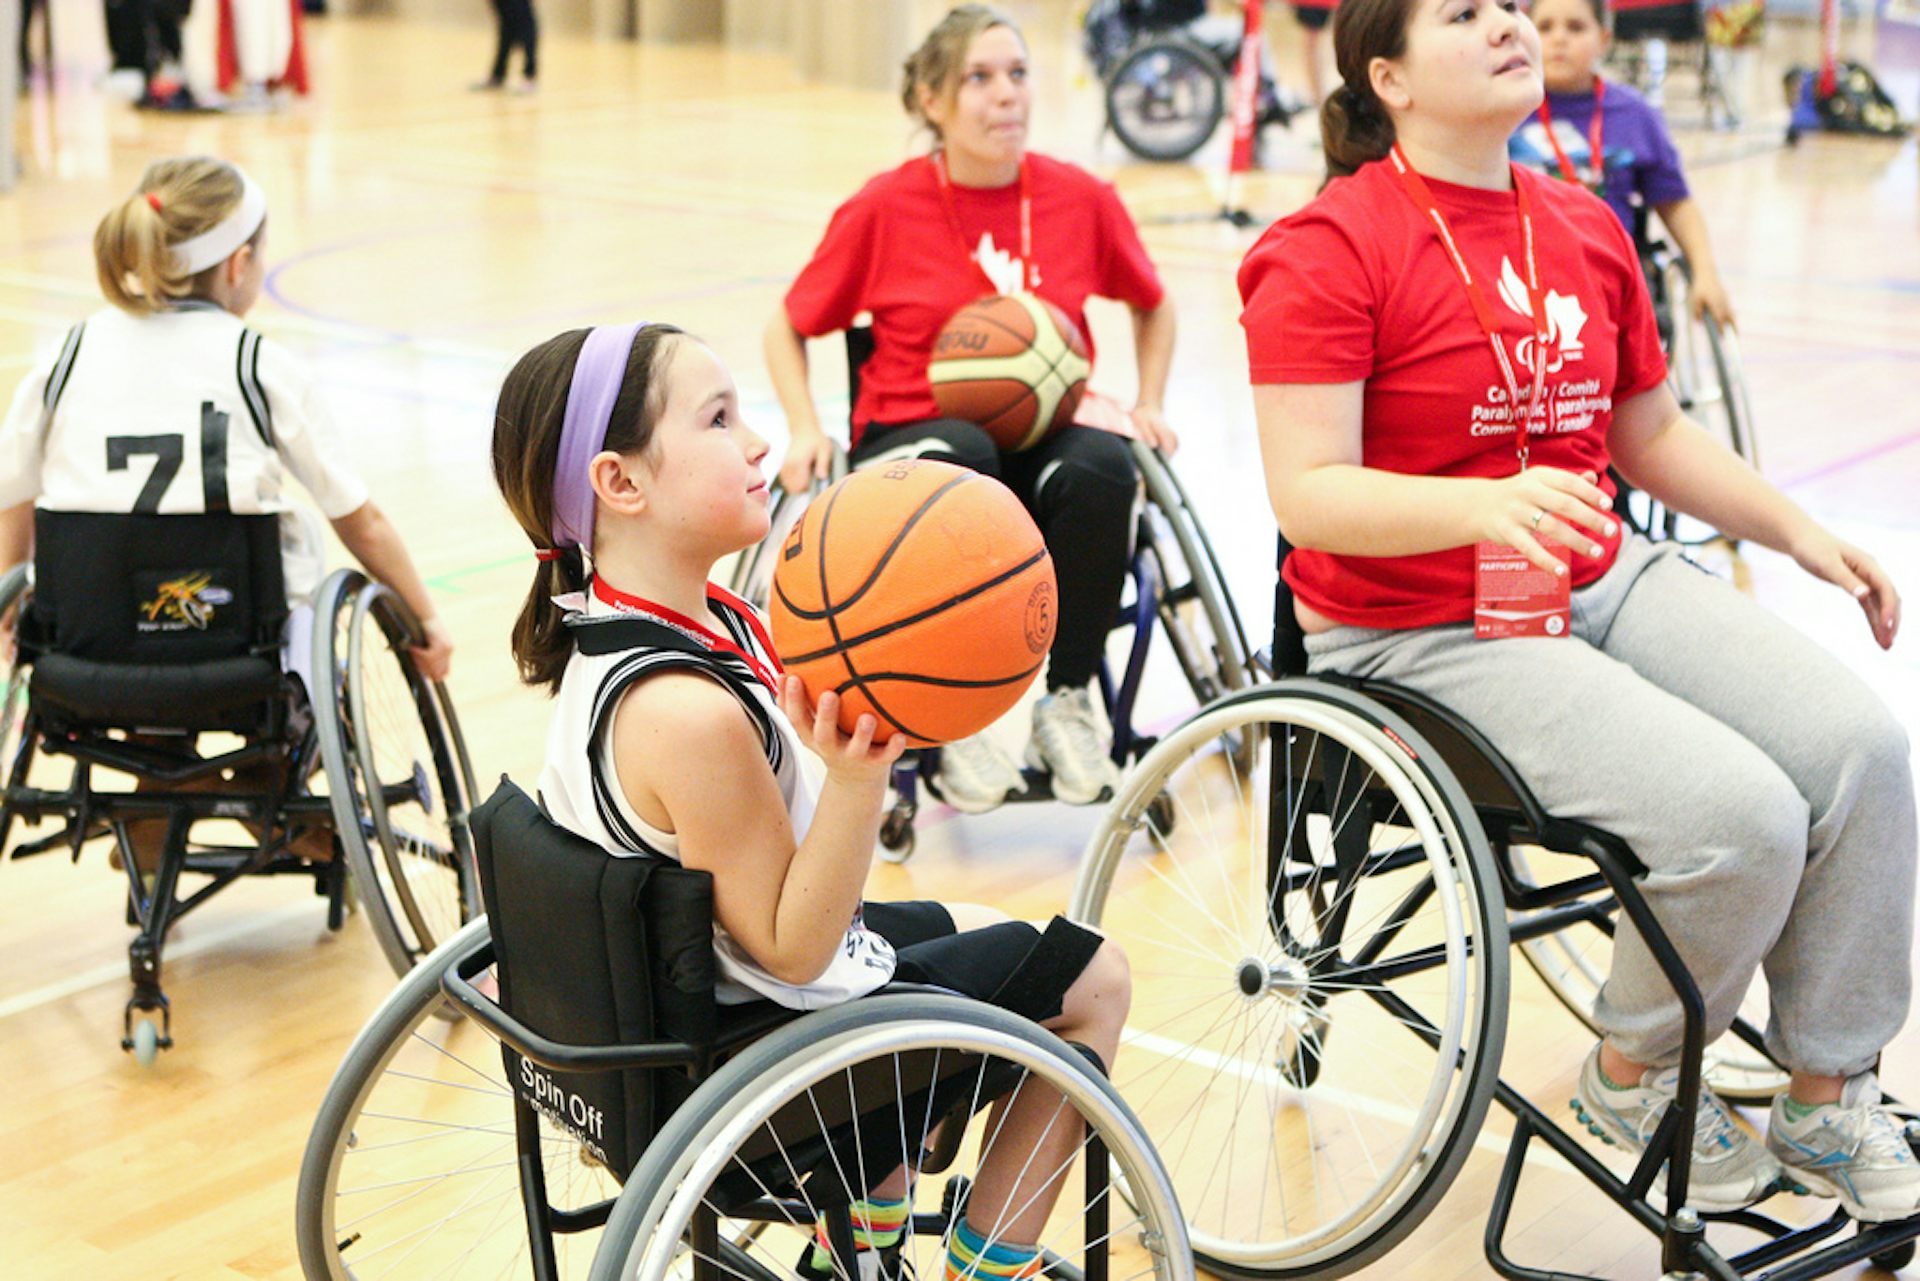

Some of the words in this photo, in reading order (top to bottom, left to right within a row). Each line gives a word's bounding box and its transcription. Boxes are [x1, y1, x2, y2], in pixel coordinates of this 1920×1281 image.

[1471, 403, 1546, 422] Paralymic
[1470, 420, 1547, 436] Commtee
[520, 1056, 566, 1113] Spin
[568, 1093, 604, 1140] Off
